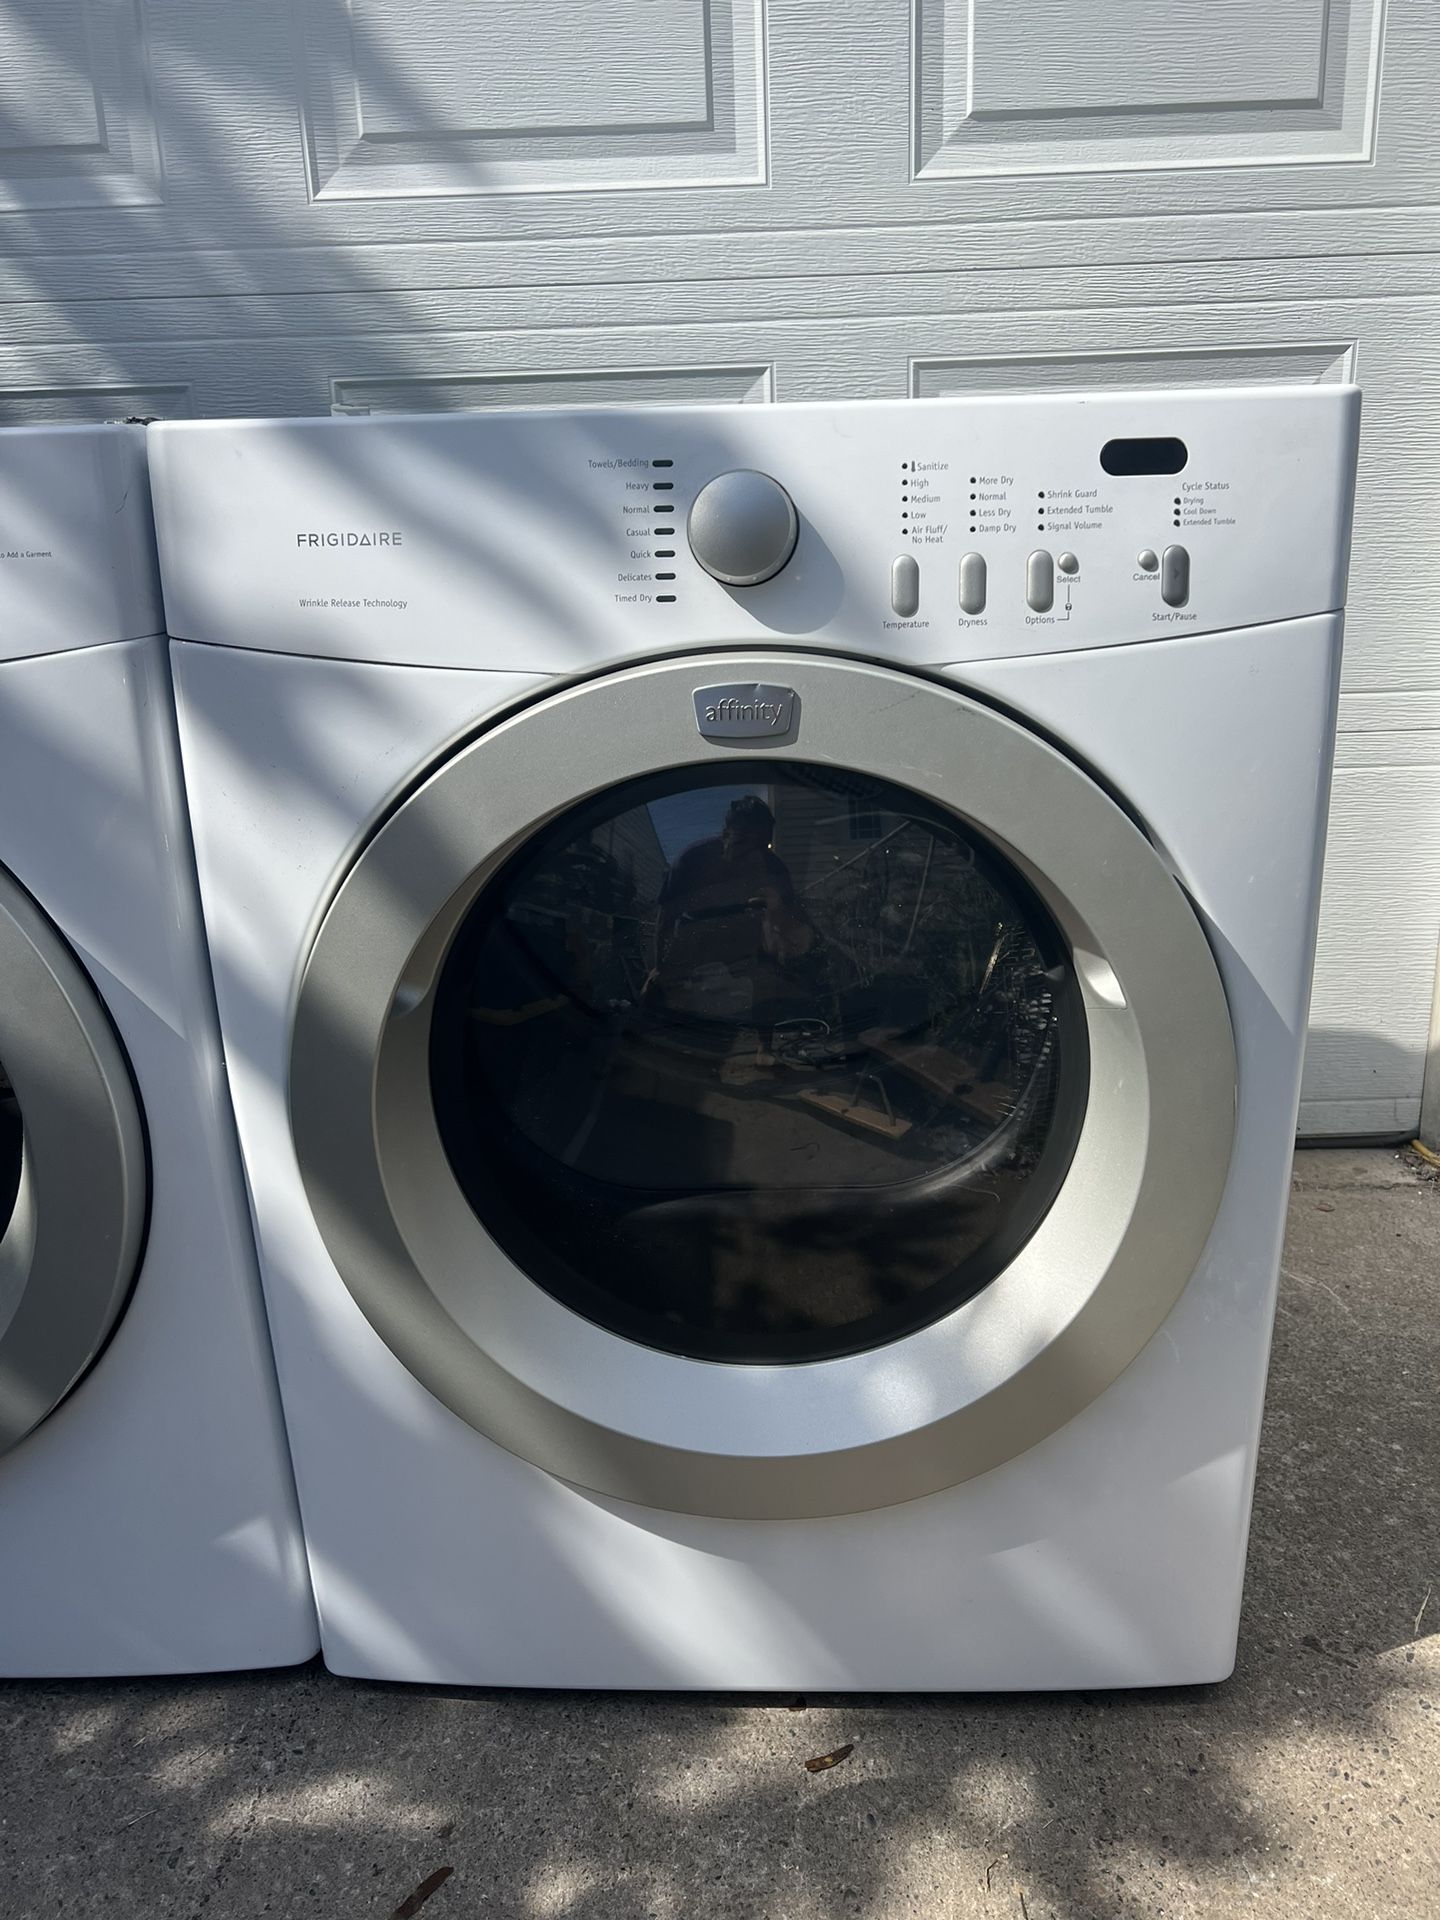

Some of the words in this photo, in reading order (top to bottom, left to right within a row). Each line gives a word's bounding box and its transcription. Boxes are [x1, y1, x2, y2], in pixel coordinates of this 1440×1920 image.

[588, 458, 649, 469] Towels/Bedding
[917, 462, 949, 471] Sanitize
[910, 478, 929, 488] High
[979, 476, 998, 485] More
[1001, 476, 1014, 486] Dry
[625, 482, 649, 492] Heavy
[1182, 482, 1202, 492] Cycle
[1205, 481, 1230, 490] Status
[910, 494, 941, 503] Medium
[979, 492, 1006, 501] Normal
[1047, 490, 1072, 499] Shrink
[1075, 489, 1097, 498] Guard
[1183, 497, 1204, 505] Drying
[622, 505, 650, 514] Normal
[979, 508, 995, 517] Less
[998, 508, 1011, 518] Dry
[1047, 505, 1082, 515] Extended
[1085, 504, 1113, 514] Tumble
[1199, 507, 1216, 515] Down
[910, 511, 926, 519] Low
[1047, 522, 1072, 532] Signal
[1074, 521, 1102, 530] Volume
[1183, 518, 1212, 526] Extended
[626, 527, 650, 537] Casual
[911, 526, 924, 534] Air
[925, 524, 948, 535] Fluff/
[979, 524, 1000, 533] Damp
[1003, 523, 1016, 533] Dry
[297, 532, 402, 547] FRIGIDAIRE
[912, 536, 922, 544] No
[925, 535, 944, 543] Heat
[7, 551, 19, 559] Add
[26, 550, 52, 558] Garment
[630, 549, 651, 560] Quick
[617, 572, 652, 582] Delicates
[1056, 575, 1081, 584] Select
[1132, 573, 1160, 581] Cancel
[614, 594, 637, 603] Timed
[639, 593, 652, 604] Dry
[299, 598, 328, 608] Wrinkle
[331, 598, 360, 608] Release
[363, 598, 408, 610] Technology
[1025, 616, 1055, 625] Options
[1152, 612, 1197, 622] Start/Pause
[882, 620, 930, 630] Temperature
[958, 618, 988, 628] Dryness
[705, 698, 782, 726] affinity
